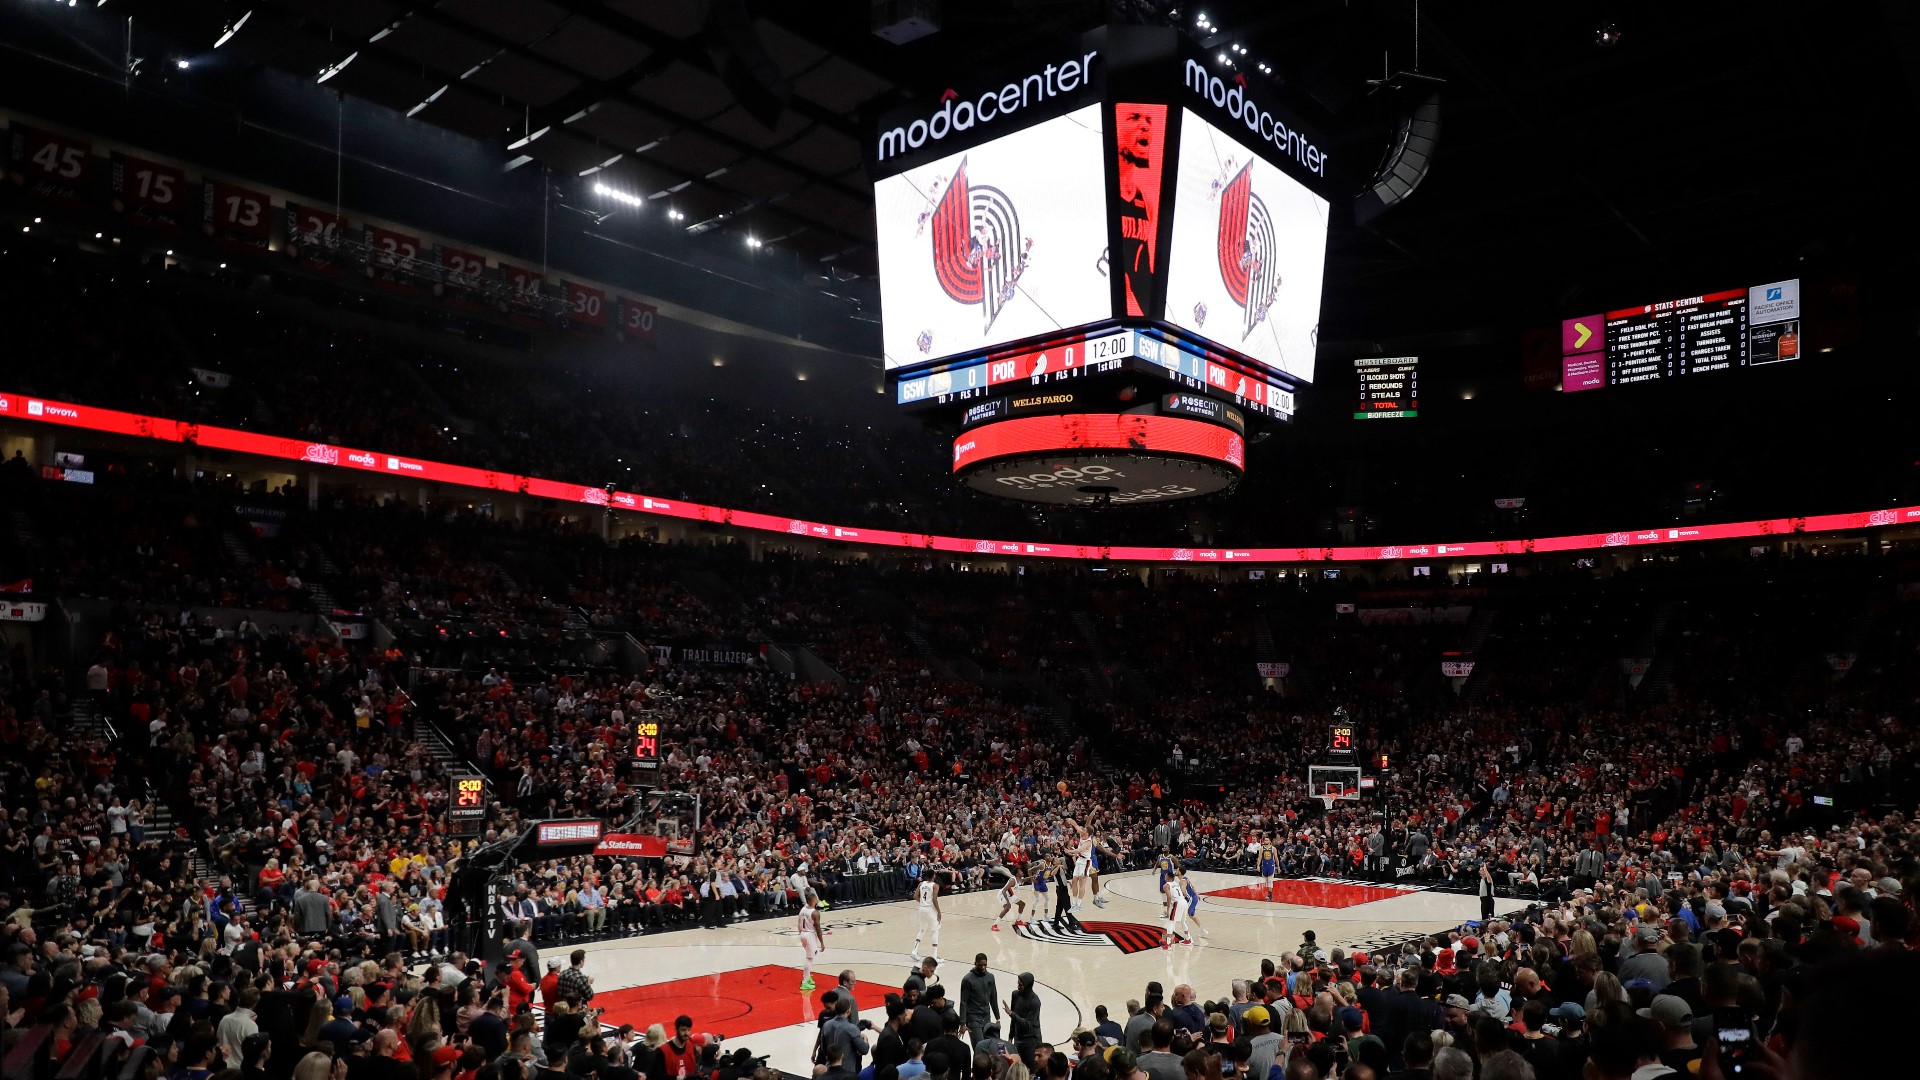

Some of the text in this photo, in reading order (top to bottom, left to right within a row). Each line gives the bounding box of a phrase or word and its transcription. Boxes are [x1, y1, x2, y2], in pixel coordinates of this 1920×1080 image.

[32, 142, 86, 179] 45
[135, 169, 176, 205] 15
[226, 196, 262, 227] 13
[450, 254, 482, 288] 22
[574, 290, 600, 316] 30
[1655, 296, 1704, 311] STATS CENTRAL
[628, 305, 654, 332] 30
[1092, 338, 1126, 359] 12:00
[1140, 337, 1159, 360] GSW
[1065, 347, 1073, 367] 0
[1108, 358, 1122, 370] QTR
[992, 360, 1015, 380] POR
[1192, 358, 1198, 376] 0
[969, 369, 975, 386] 0
[1032, 368, 1077, 385] TO 7 FLS 0
[1210, 365, 1226, 386] POR
[903, 379, 926, 400] GSW
[939, 395, 946, 404] TO
[960, 390, 971, 399] FLS
[1256, 383, 1260, 400] 0
[1013, 395, 1073, 408] WELLS FARGO
[1271, 390, 1289, 410] 12:00
[45, 406, 77, 418] TOYOTA
[1186, 406, 1214, 417] PARTNERS
[306, 442, 338, 465] city
[959, 441, 976, 454] TOYOTA
[349, 453, 374, 464] moda
[400, 462, 423, 471] TOYOTA
[996, 464, 1115, 485] moda
[1869, 510, 1898, 526] city
[1907, 509, 1920, 517] mo
[1606, 532, 1630, 546] city
[1638, 531, 1658, 540] moda
[976, 540, 996, 553] city
[1002, 543, 1018, 552] moda
[1173, 548, 1193, 560] city
[1380, 546, 1402, 559] city
[1200, 550, 1217, 559] moda
[682, 649, 710, 662] TRAIL
[714, 651, 752, 664] BLAZERS
[638, 723, 657, 736] 12:00
[636, 736, 656, 757] 24
[1334, 736, 1349, 748] 24
[458, 791, 478, 806] 24
[923, 892, 927, 901] 4
[487, 885, 496, 940] NBA TV
[803, 919, 806, 929] 1
